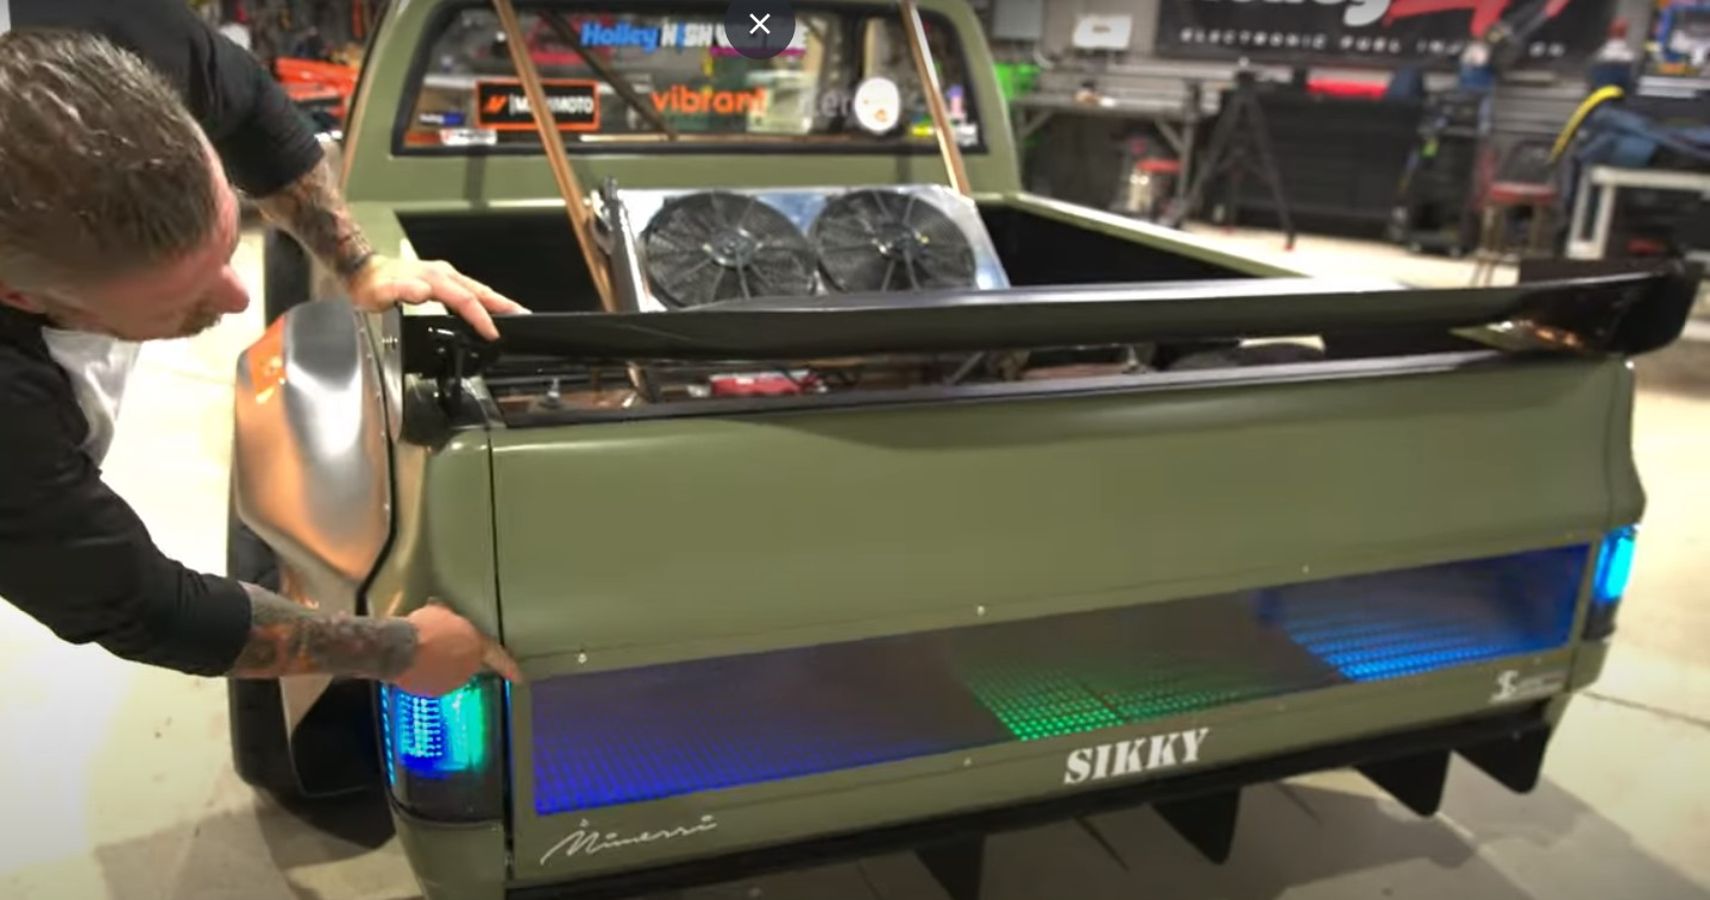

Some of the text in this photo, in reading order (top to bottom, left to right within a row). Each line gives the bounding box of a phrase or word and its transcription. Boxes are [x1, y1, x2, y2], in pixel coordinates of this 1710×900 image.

[580, 21, 658, 53] Holley
[1180, 28, 1327, 49] ELECTRONIC
[1340, 35, 1401, 53] FUEL
[651, 85, 767, 114] vibrant
[1064, 727, 1210, 785] SIKKY
